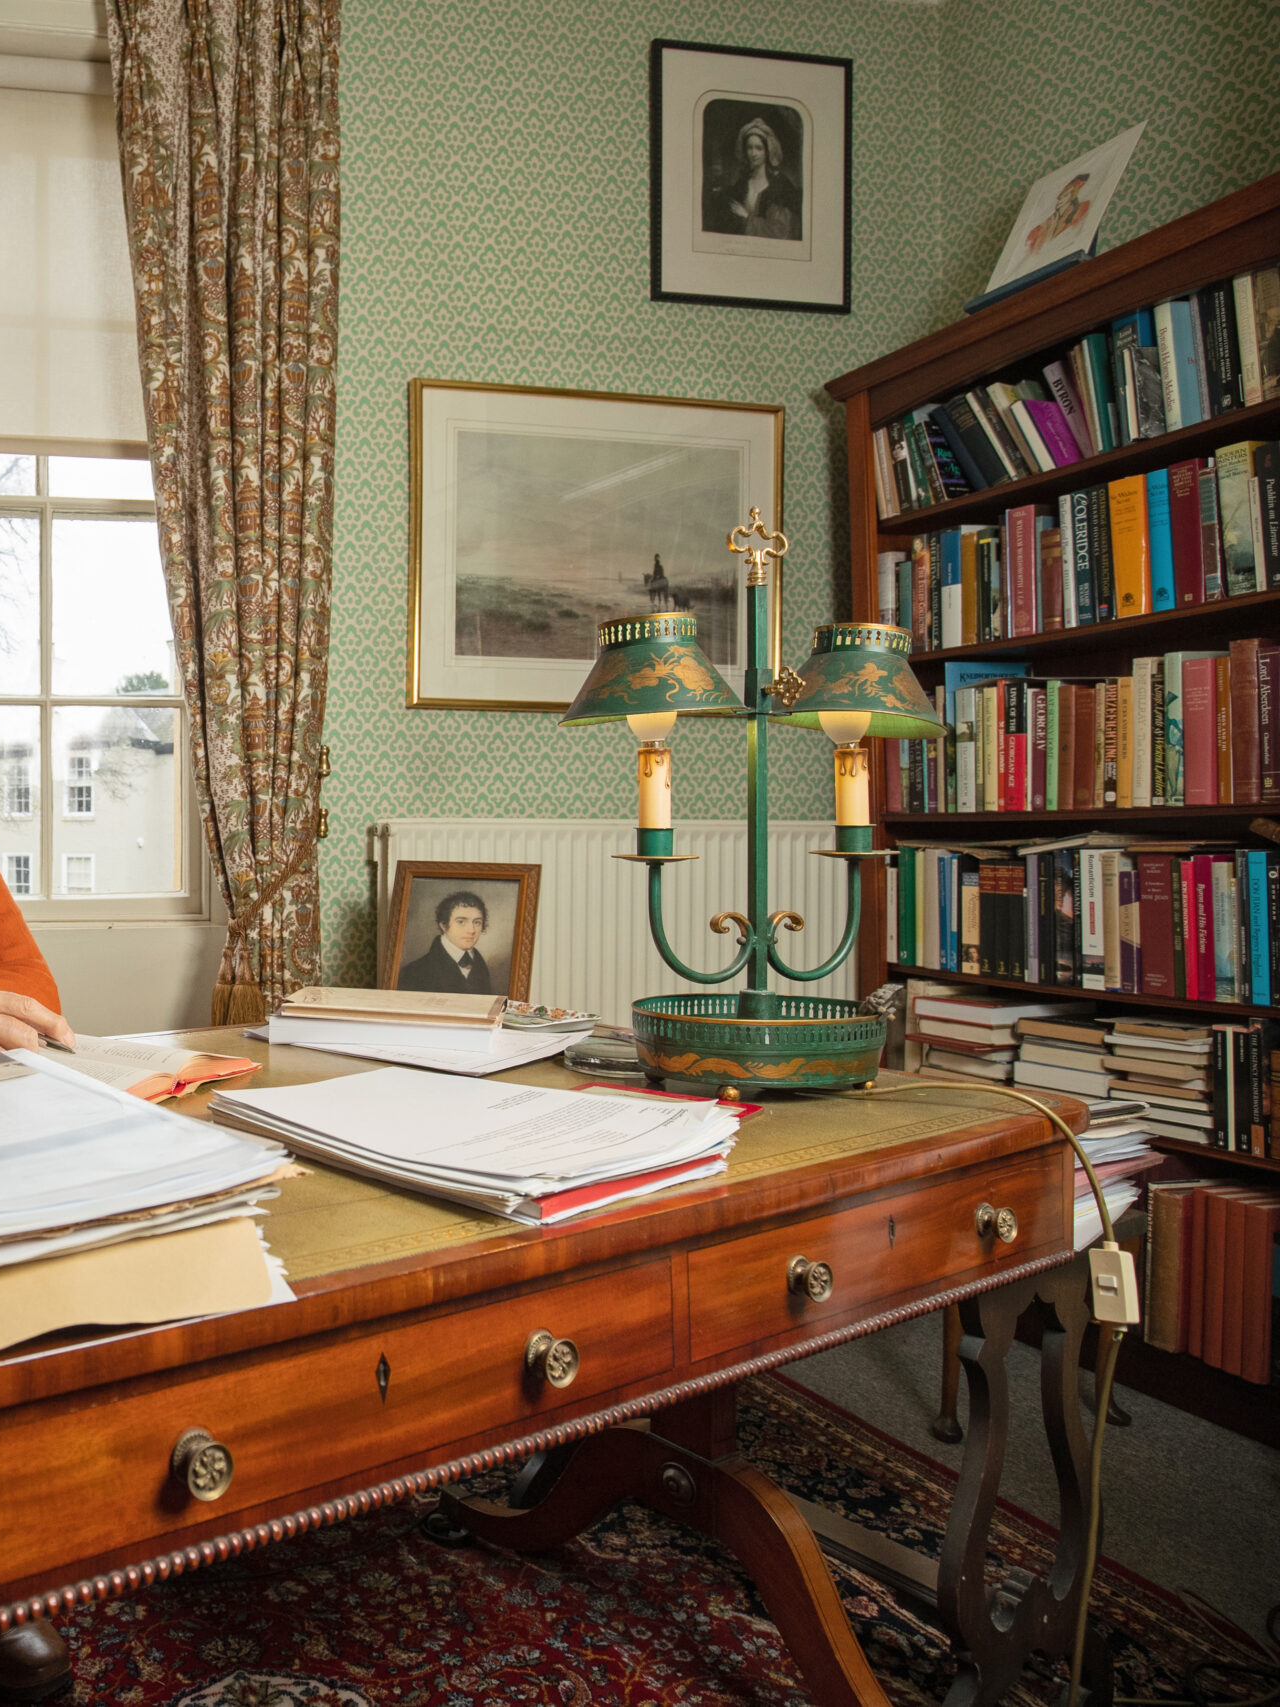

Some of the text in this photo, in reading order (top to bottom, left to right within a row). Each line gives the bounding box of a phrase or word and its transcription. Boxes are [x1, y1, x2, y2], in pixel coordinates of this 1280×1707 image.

[1159, 327, 1174, 413] Byron's Hebrew Melodies
[1052, 378, 1076, 416] BYRON
[1265, 478, 1275, 508] Pushkin
[1072, 491, 1089, 571] COLERIDGE
[1268, 521, 1280, 557] Literature
[930, 537, 939, 588] SHERIDAN
[1009, 687, 1017, 706] LIVES
[1009, 707, 1016, 717] OF
[1260, 658, 1272, 725] Lord Aberdeen
[1036, 695, 1046, 741] GEORGE
[1105, 684, 1117, 762] PRIZEFIGHTING
[1008, 736, 1016, 788] GEORGIAN AGE
[1087, 854, 1096, 898] Romanticism
[1251, 878, 1260, 895] DON
[1197, 883, 1208, 954] Byron and His Fictions
[1251, 895, 1261, 914] JUAN
[1253, 915, 1261, 927] and
[1252, 1077, 1260, 1123] UNDERWORLD
